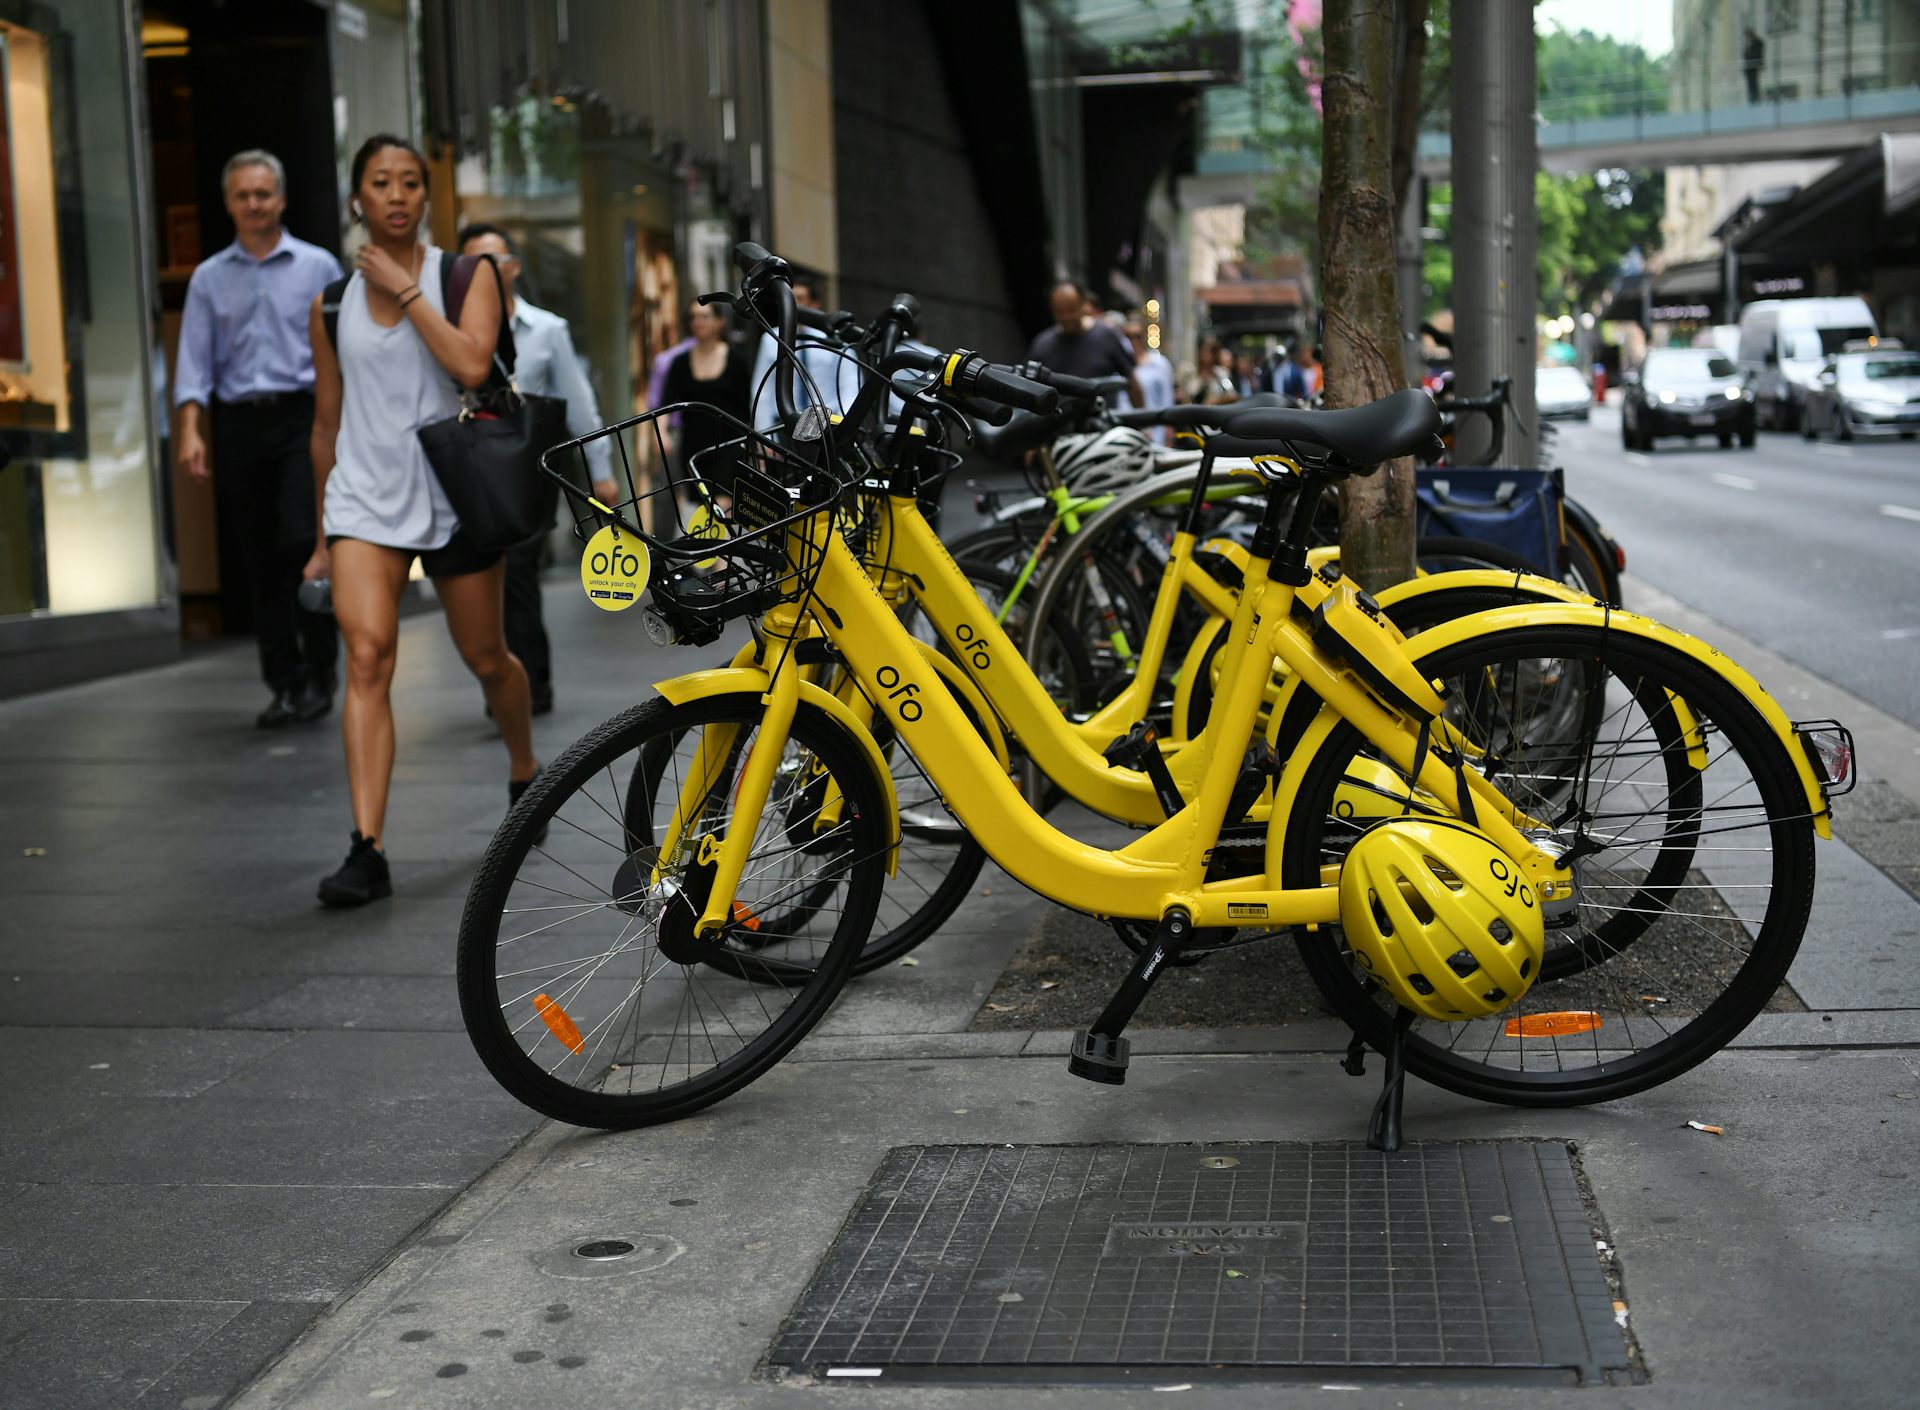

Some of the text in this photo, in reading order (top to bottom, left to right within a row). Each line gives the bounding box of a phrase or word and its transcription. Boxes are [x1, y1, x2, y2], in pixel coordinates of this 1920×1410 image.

[742, 492, 779, 520] Share more
[591, 544, 639, 577] ofo
[625, 581, 637, 589] city
[956, 624, 990, 670] ofo
[876, 665, 923, 722] ofo
[1489, 858, 1534, 909] ofo
